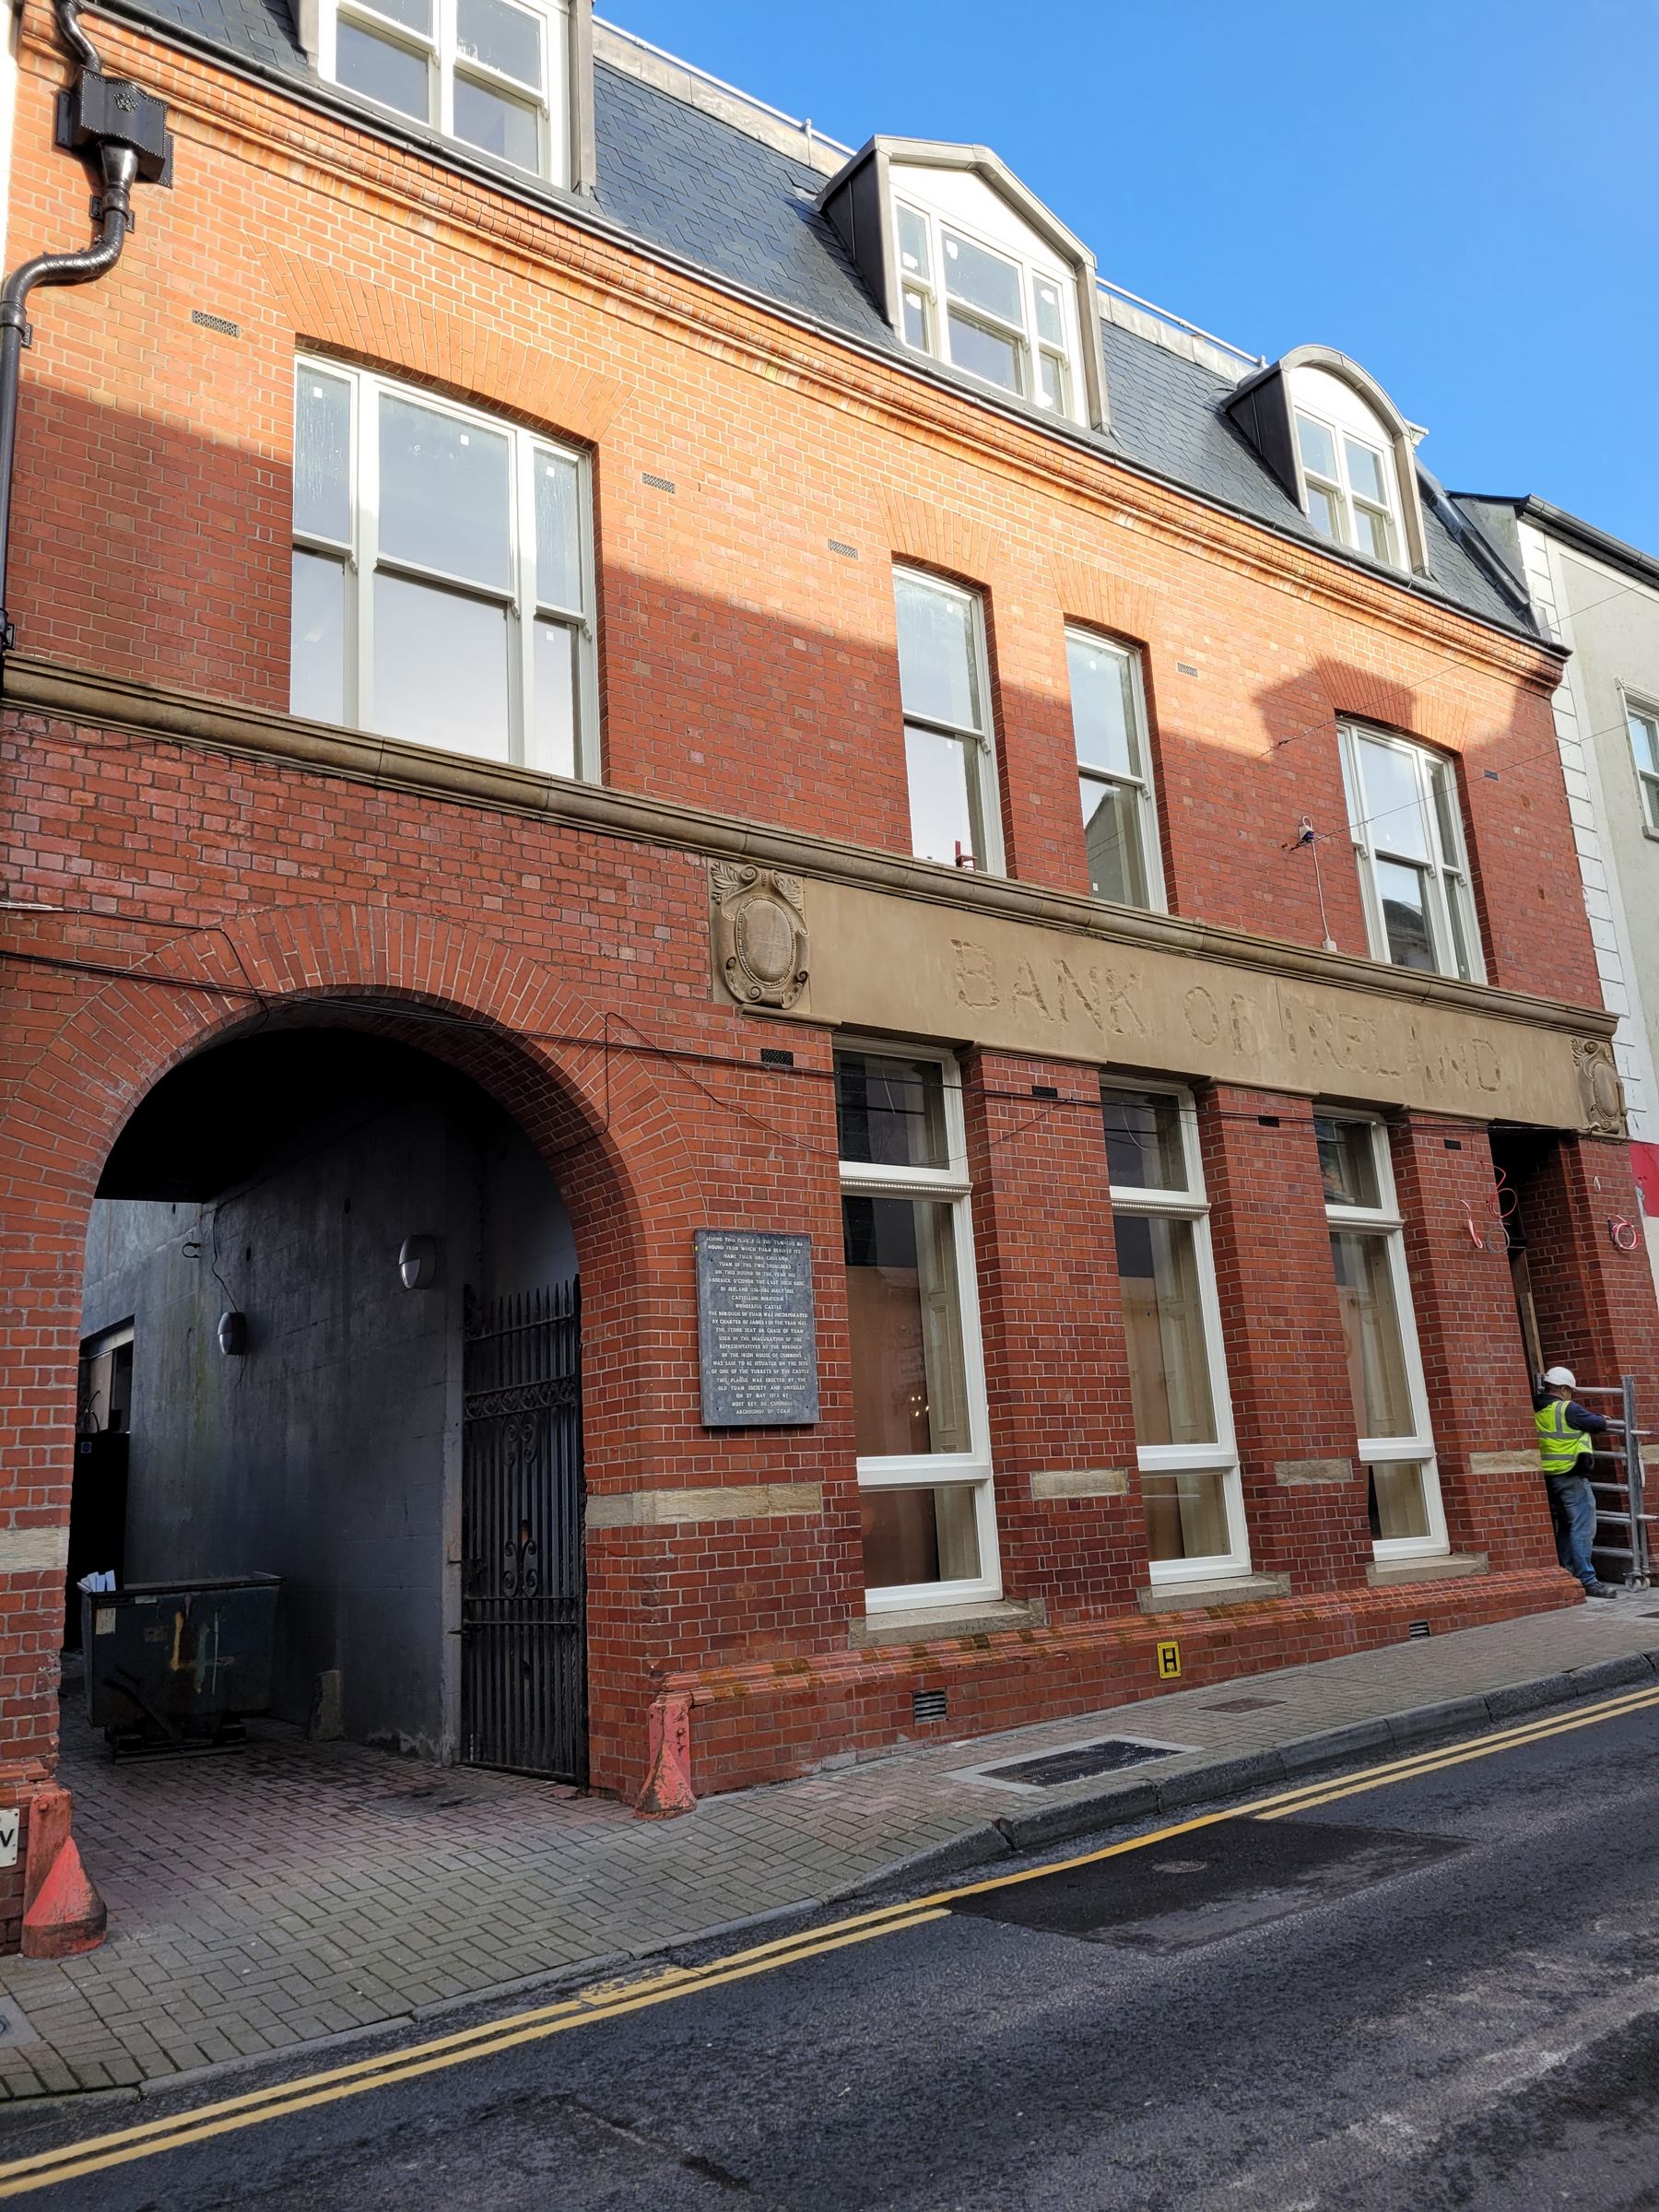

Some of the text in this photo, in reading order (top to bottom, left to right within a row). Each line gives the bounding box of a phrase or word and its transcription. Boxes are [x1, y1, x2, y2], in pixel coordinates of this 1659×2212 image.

[951, 938, 1148, 1039] BANK
[1282, 1000, 1503, 1093] IRELAND
[1162, 1647, 1178, 1673] H
